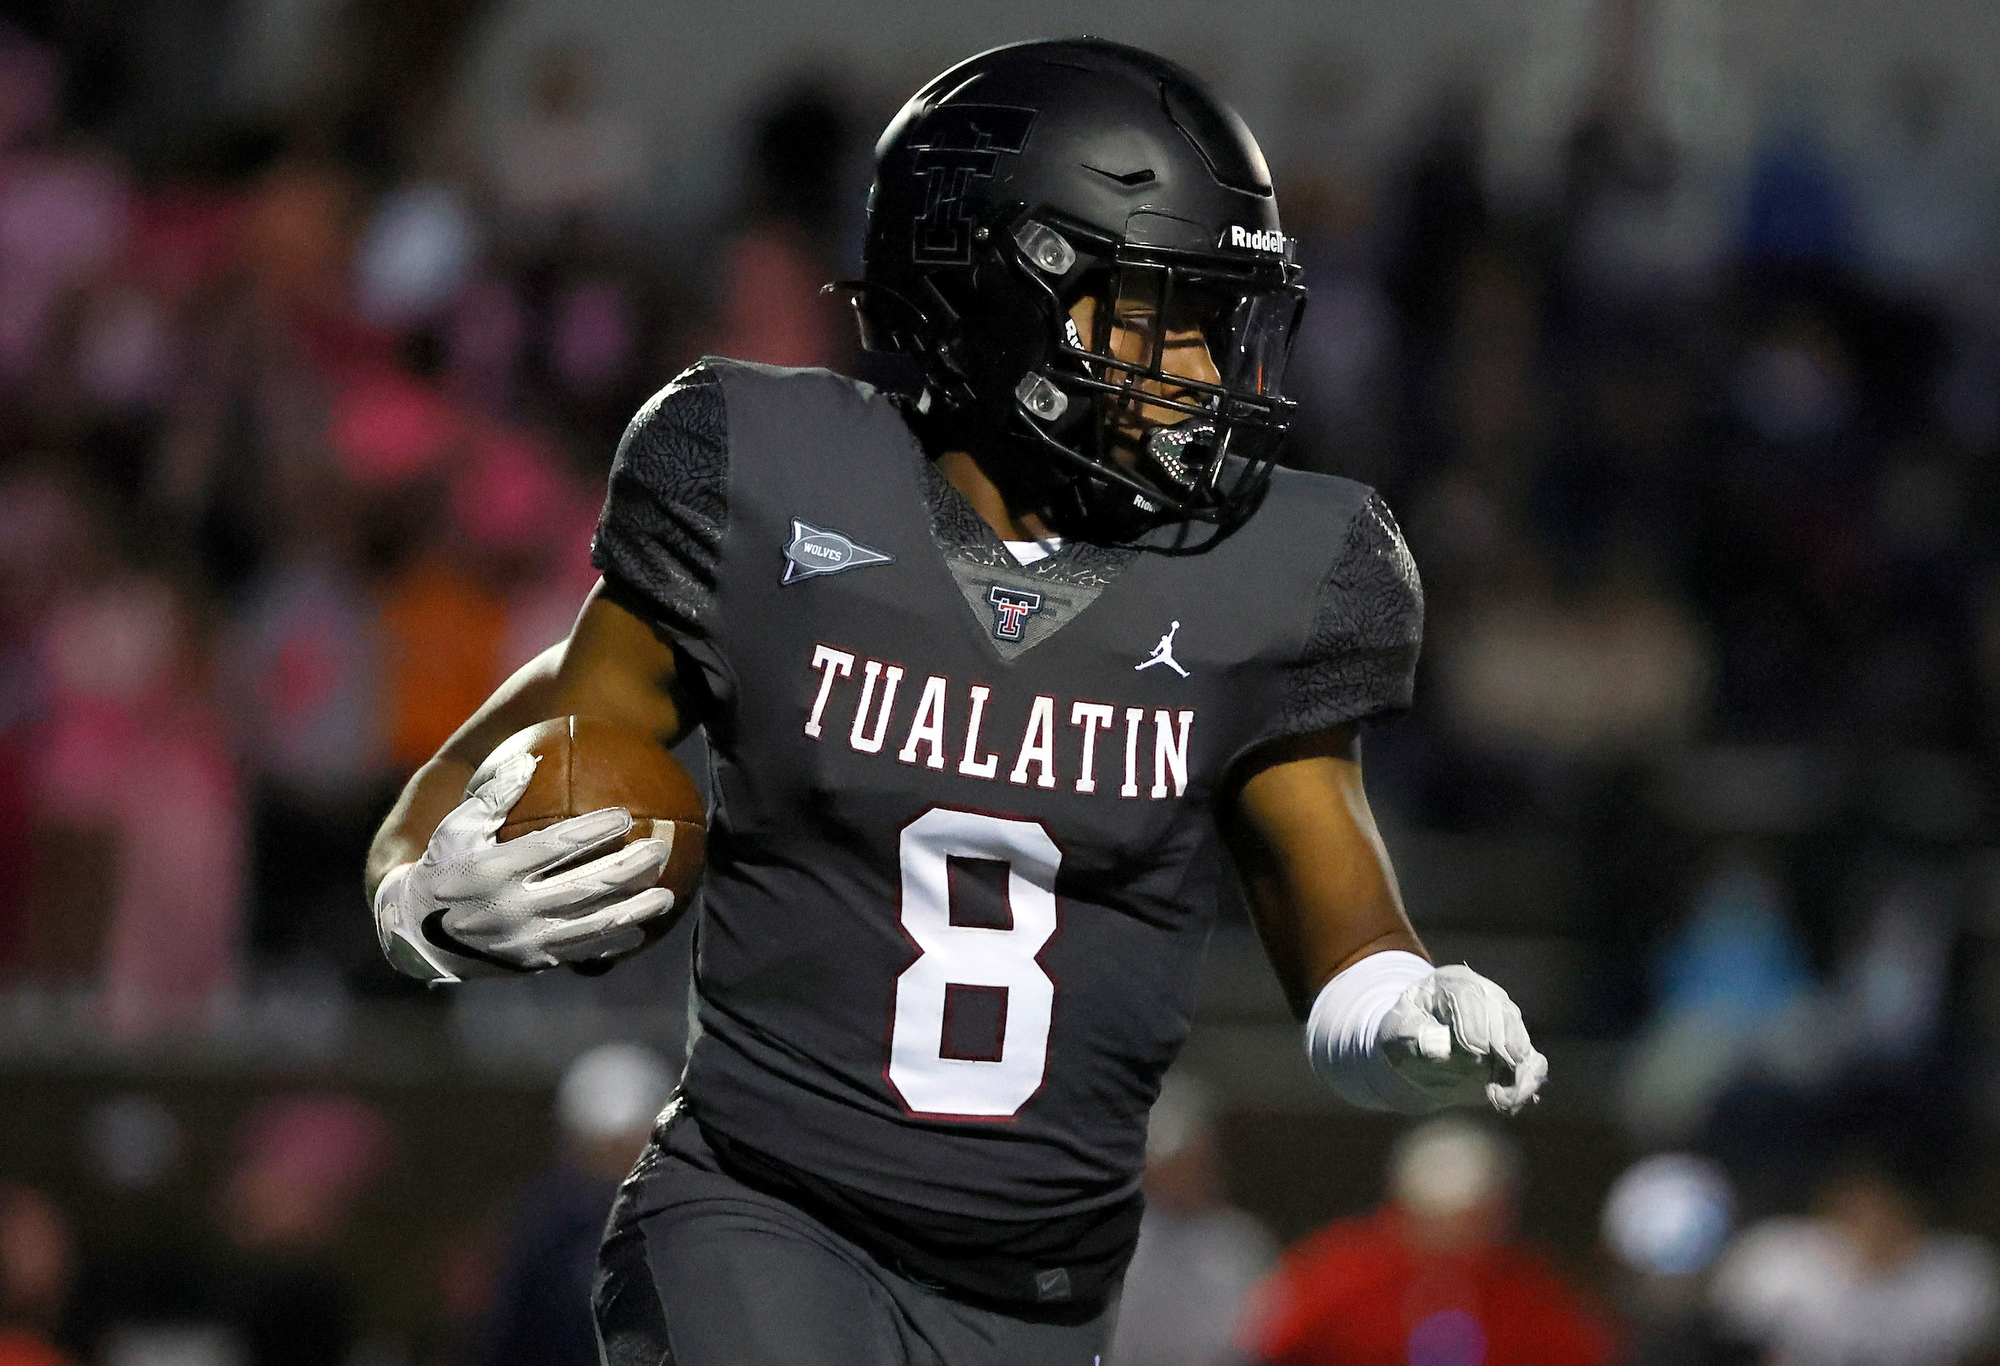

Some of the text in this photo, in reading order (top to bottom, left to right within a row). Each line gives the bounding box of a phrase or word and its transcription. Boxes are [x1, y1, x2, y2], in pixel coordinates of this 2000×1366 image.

[803, 541, 842, 562] WOLVES
[803, 643, 1195, 800] TUALATIN
[888, 806, 1063, 1119] 8
